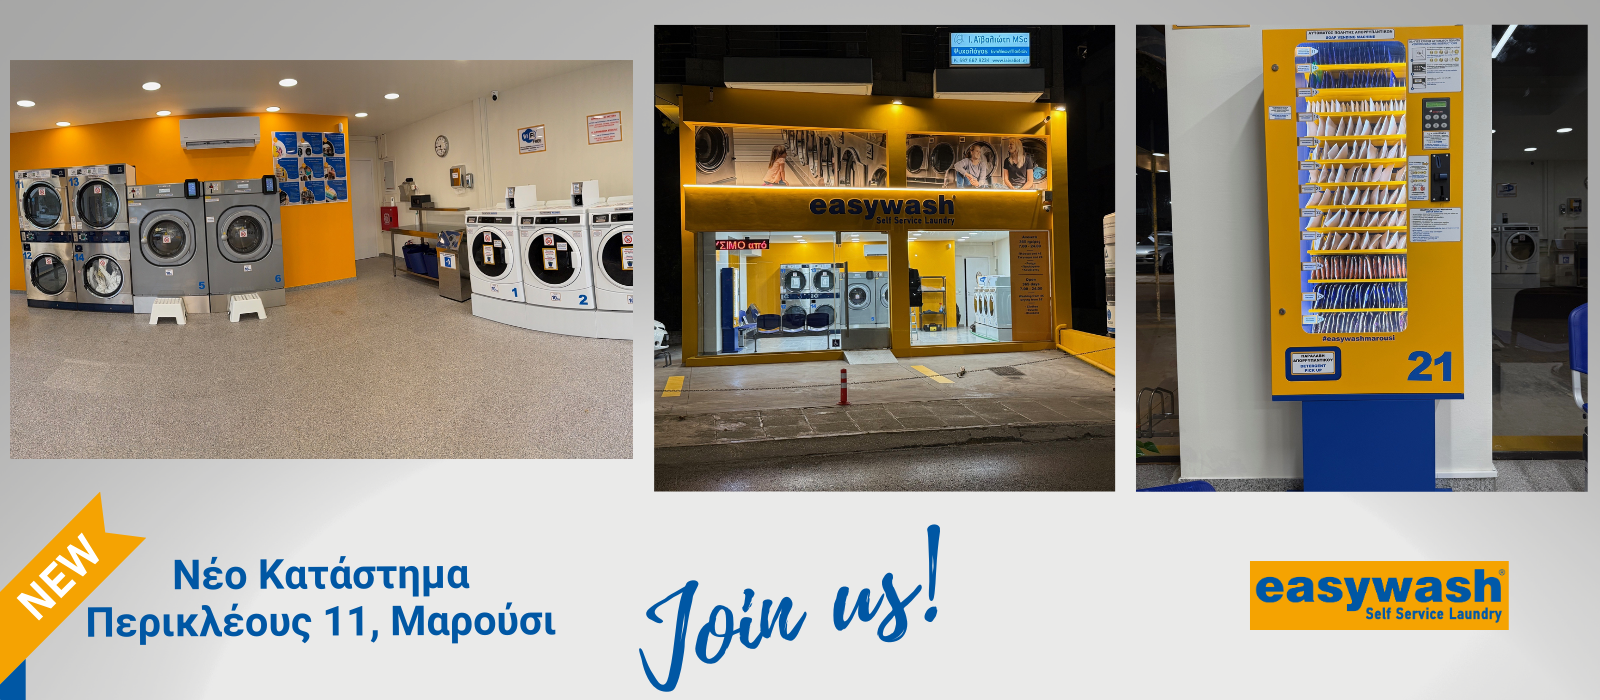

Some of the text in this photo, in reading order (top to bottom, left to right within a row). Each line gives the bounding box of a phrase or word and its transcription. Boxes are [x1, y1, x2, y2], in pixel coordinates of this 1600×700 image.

[1012, 35, 1028, 43] MSc
[953, 47, 989, 55] Ψυχολόγος
[15, 180, 25, 189] 11
[68, 177, 80, 187] 13
[809, 194, 955, 221] easywash
[876, 216, 955, 226] Self Service Laundry
[748, 240, 768, 250] από
[22, 252, 33, 260] 12
[73, 253, 85, 262] 14
[274, 274, 282, 283] 6
[198, 281, 206, 290] 5
[511, 287, 519, 298] 1
[578, 294, 589, 306] 2
[1322, 334, 1396, 343] #easywashmarousi
[1407, 350, 1452, 382] 21
